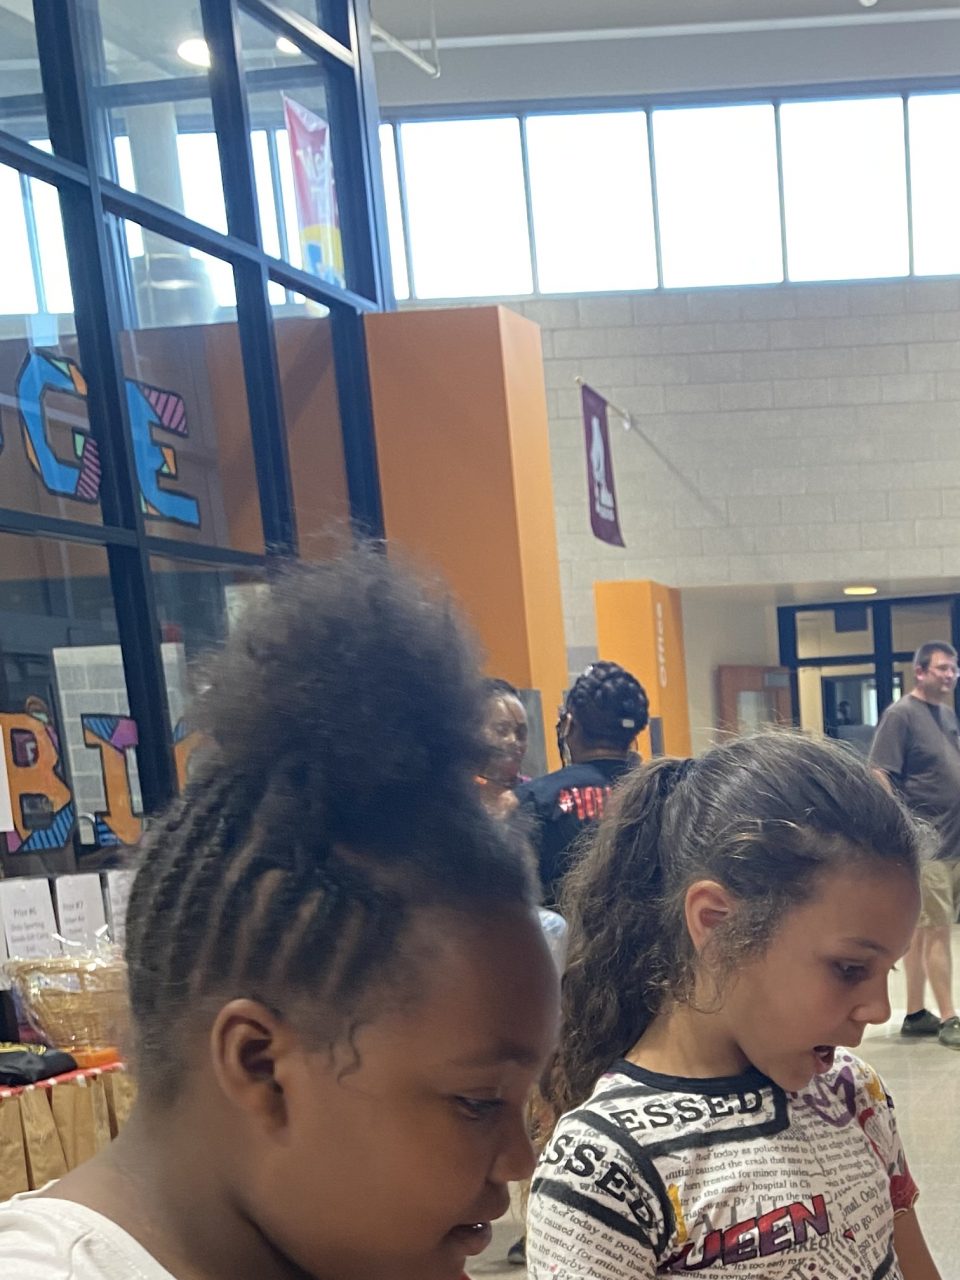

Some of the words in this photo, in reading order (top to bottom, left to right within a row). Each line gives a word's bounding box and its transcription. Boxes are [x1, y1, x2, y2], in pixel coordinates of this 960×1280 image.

[713, 1147, 739, 1159] today
[753, 1144, 780, 1157] police
[752, 1168, 779, 1178] minor
[752, 1179, 787, 1193] hospital
[569, 1213, 601, 1236] today
[615, 1239, 648, 1262] police
[575, 1231, 594, 1246] the
[595, 1243, 624, 1264] crash
[576, 1247, 594, 1261] for
[595, 1257, 628, 1276] minor
